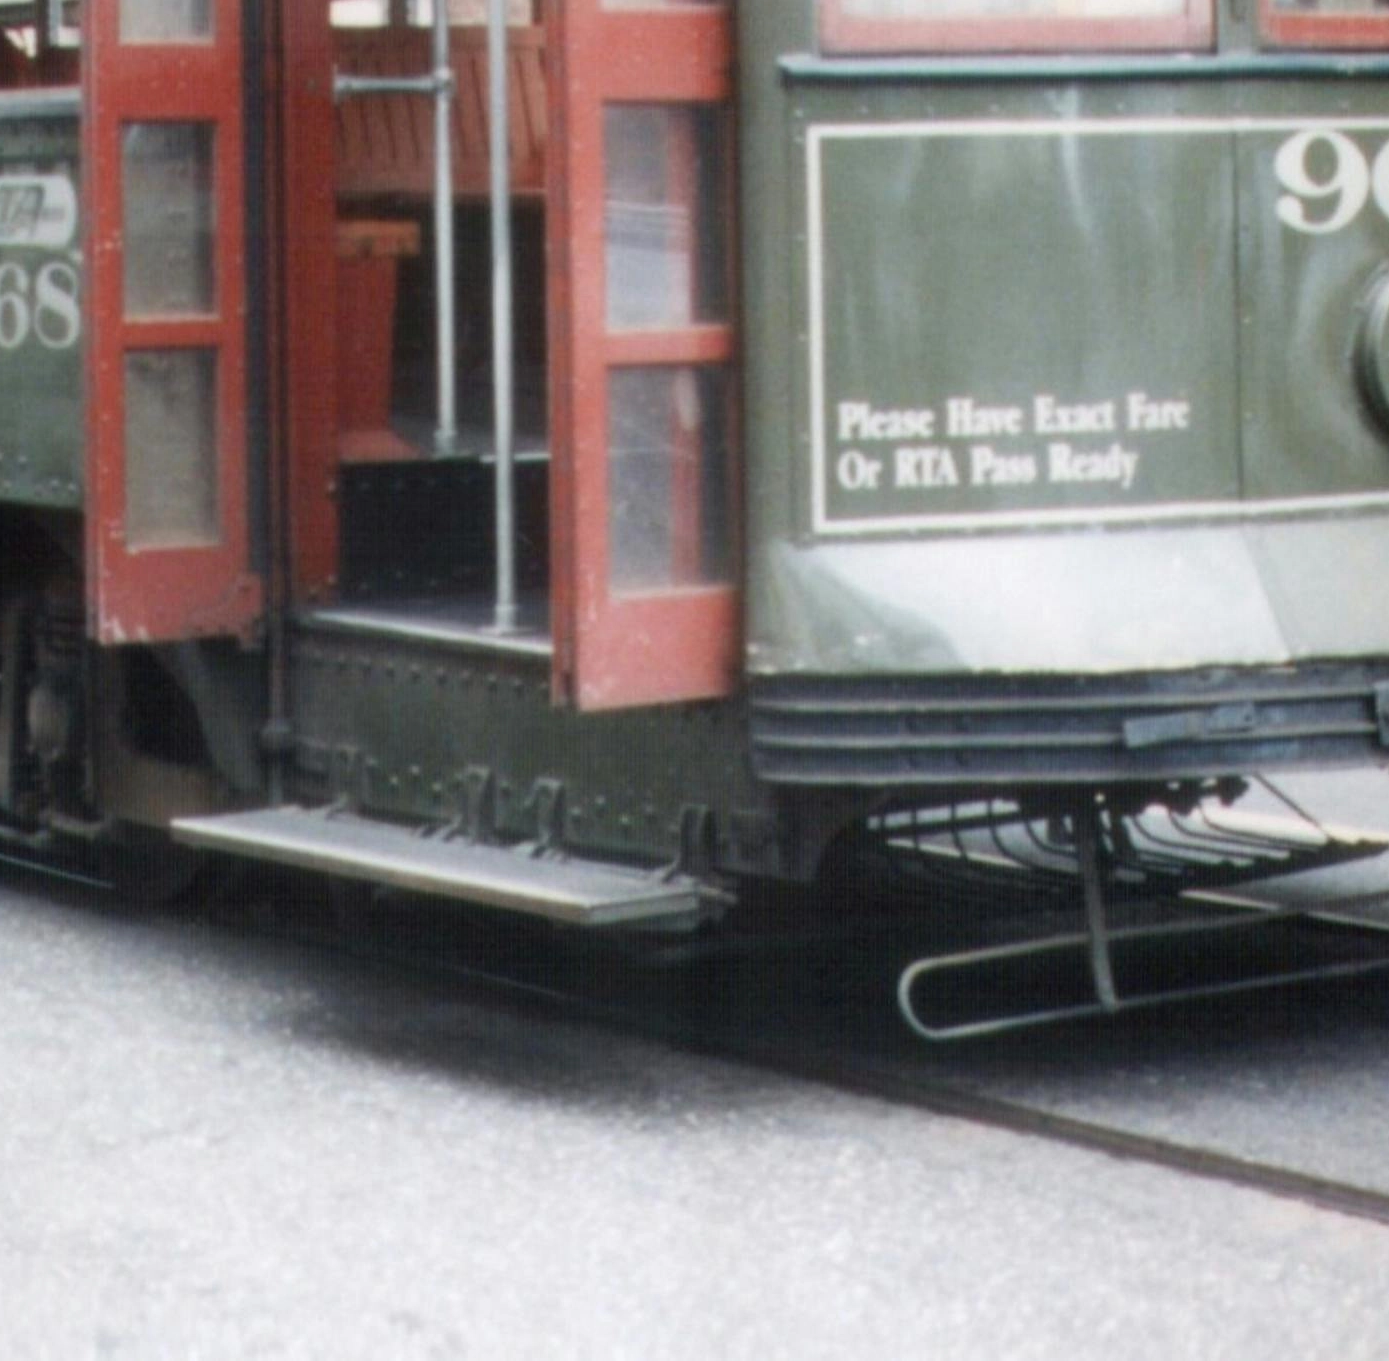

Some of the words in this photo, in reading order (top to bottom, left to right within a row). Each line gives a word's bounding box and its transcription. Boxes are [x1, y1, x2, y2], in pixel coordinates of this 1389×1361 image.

[837, 401, 935, 440] Please
[946, 397, 1024, 437] Have
[1033, 394, 1116, 434] Exact
[1126, 391, 1190, 431] Fare
[837, 450, 883, 490] Or
[894, 446, 959, 488] RTA
[969, 444, 1038, 487] Pass
[1048, 441, 1140, 489] Ready
